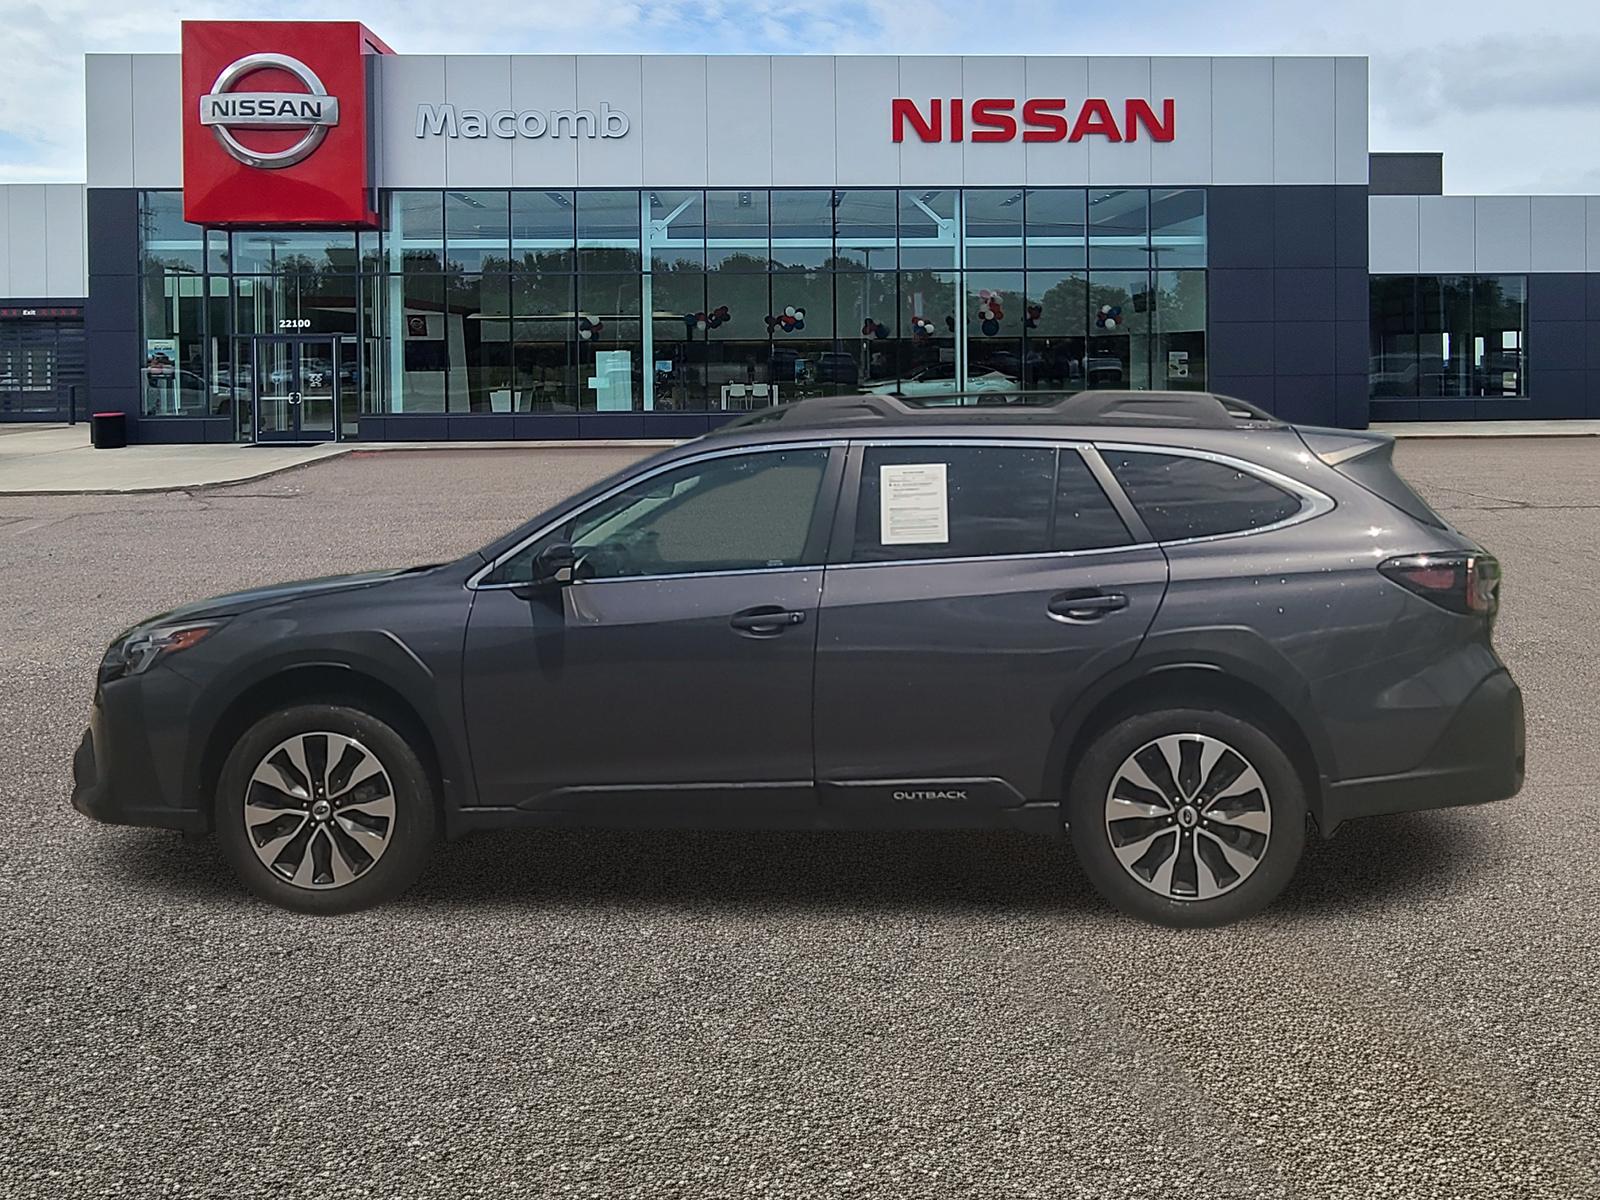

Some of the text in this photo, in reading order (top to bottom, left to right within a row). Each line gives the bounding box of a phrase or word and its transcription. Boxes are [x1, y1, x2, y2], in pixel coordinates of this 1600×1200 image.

[212, 100, 322, 117] NISSAN
[415, 102, 630, 139] Macomb
[892, 98, 1175, 143] NISSAN
[279, 319, 311, 328] 22100
[893, 791, 968, 800] OUTBACK
